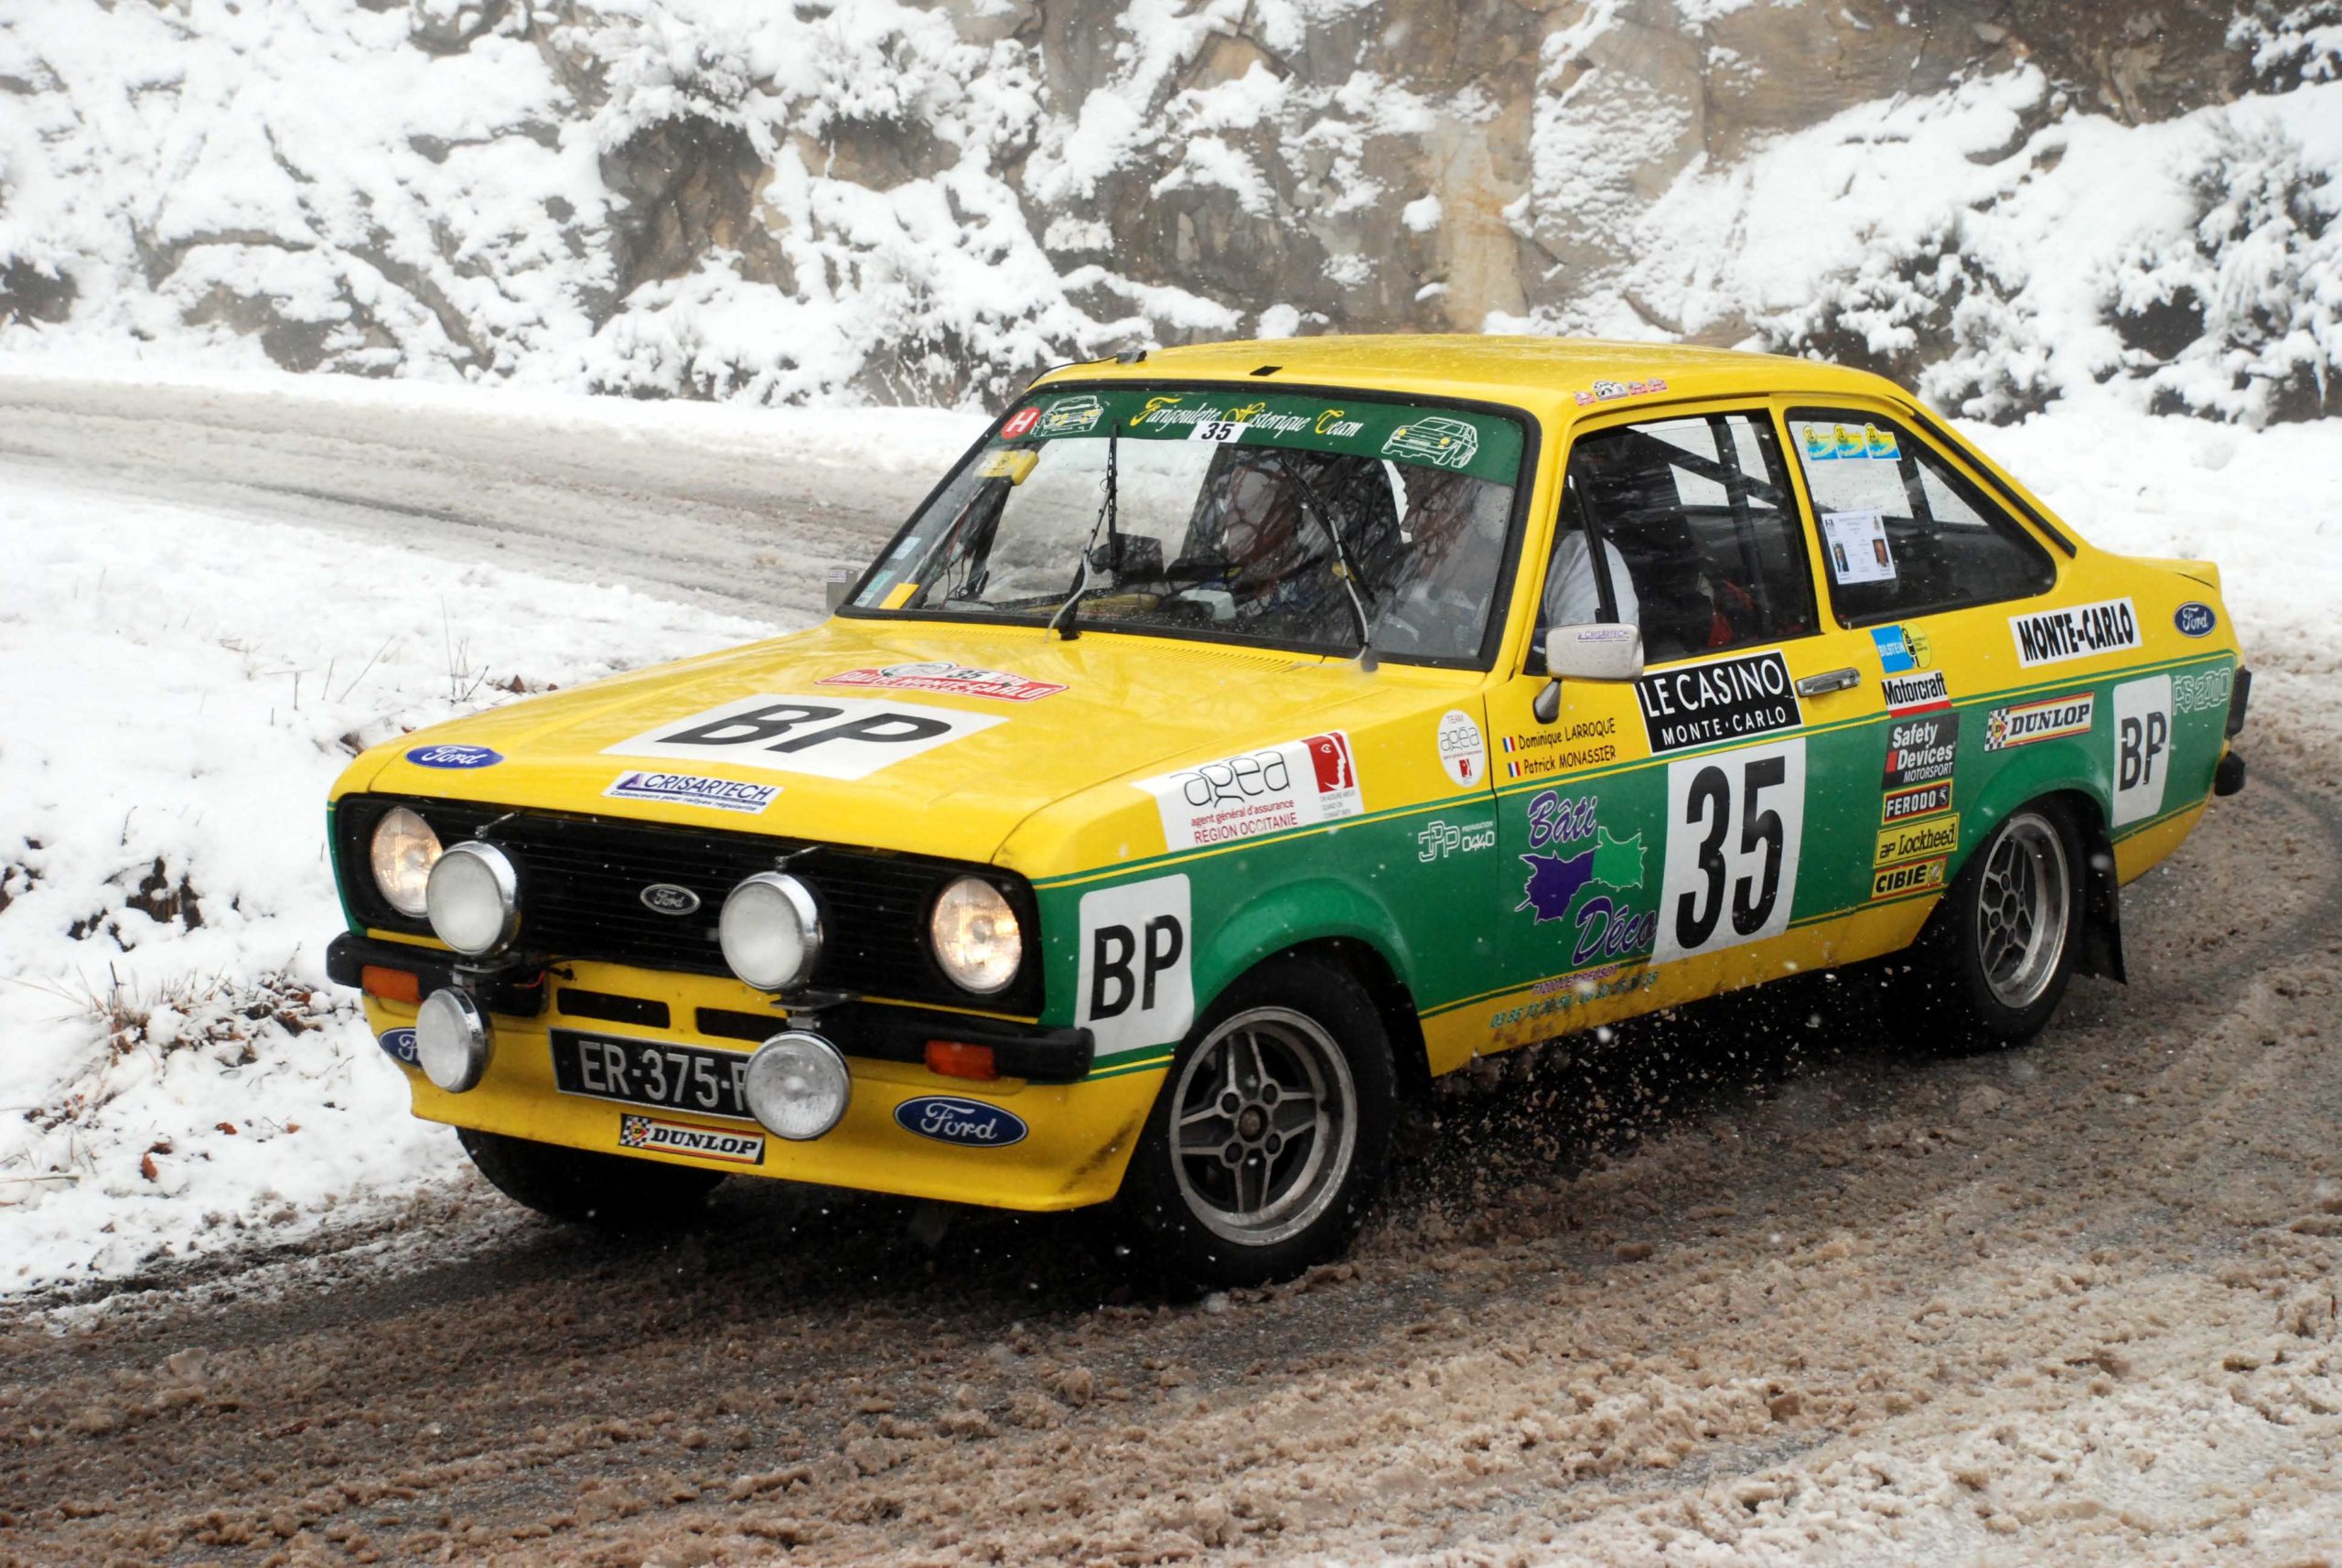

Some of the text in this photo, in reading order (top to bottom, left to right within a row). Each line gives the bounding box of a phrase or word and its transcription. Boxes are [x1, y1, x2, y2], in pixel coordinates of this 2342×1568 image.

[1006, 411, 1037, 433] H
[1201, 422, 1235, 440] 35
[1222, 402, 1311, 439] Historique
[1315, 409, 1364, 437] Team
[2016, 602, 2133, 661] MONTE-CARLO
[2182, 607, 2208, 631] Ford
[946, 670, 991, 679] 35
[1639, 659, 1783, 717] LE CASINO
[1881, 671, 1948, 705] Motorcraft
[653, 703, 951, 754] BP
[1519, 717, 1616, 749] Dominique LARROQUE
[2009, 703, 2090, 736] DUNLOP
[1892, 722, 1939, 748] Safety
[421, 746, 489, 765] Ford
[1523, 745, 1617, 775] Patrick MONASSIER
[1897, 744, 1953, 771] Devices
[2119, 711, 2167, 792] BP
[644, 774, 776, 800] CRISARTECH
[1904, 761, 1953, 784] MOTORSPORT
[1885, 790, 1937, 817] FERODO
[1191, 813, 1215, 828] agent
[1240, 812, 1298, 834] OCCITANIE
[1528, 790, 1597, 849] Bâti
[1676, 756, 1786, 950] 35
[1898, 823, 1955, 855] Lockheed
[1875, 865, 1928, 893] CIBIE
[652, 889, 685, 908] Ford
[1571, 896, 1658, 966] Déco
[1090, 914, 1184, 1022] BP
[920, 1102, 998, 1140] Ford
[650, 1124, 758, 1155] DUNLOP
